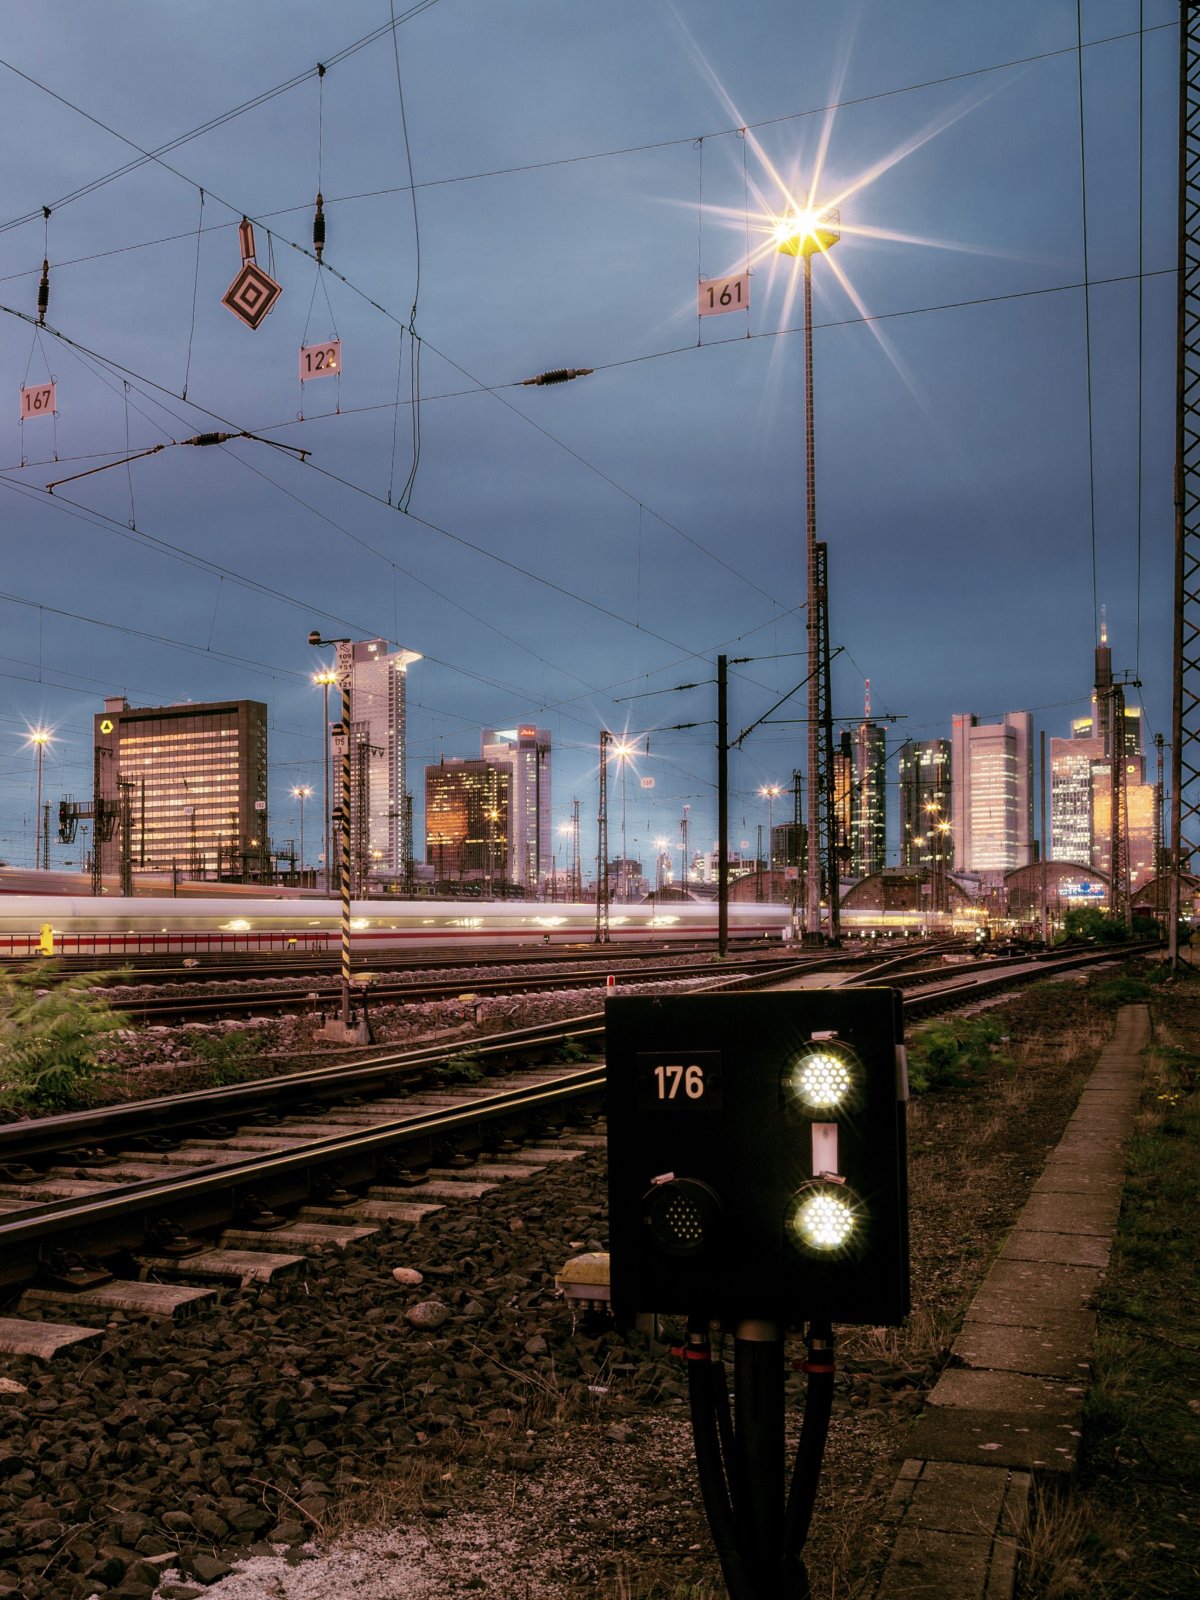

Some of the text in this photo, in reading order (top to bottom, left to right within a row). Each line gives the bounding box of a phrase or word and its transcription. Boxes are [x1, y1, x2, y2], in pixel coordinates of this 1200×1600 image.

[707, 281, 742, 308] 161
[305, 348, 336, 372] 122
[25, 389, 51, 411] 167
[654, 1065, 704, 1099] 176
